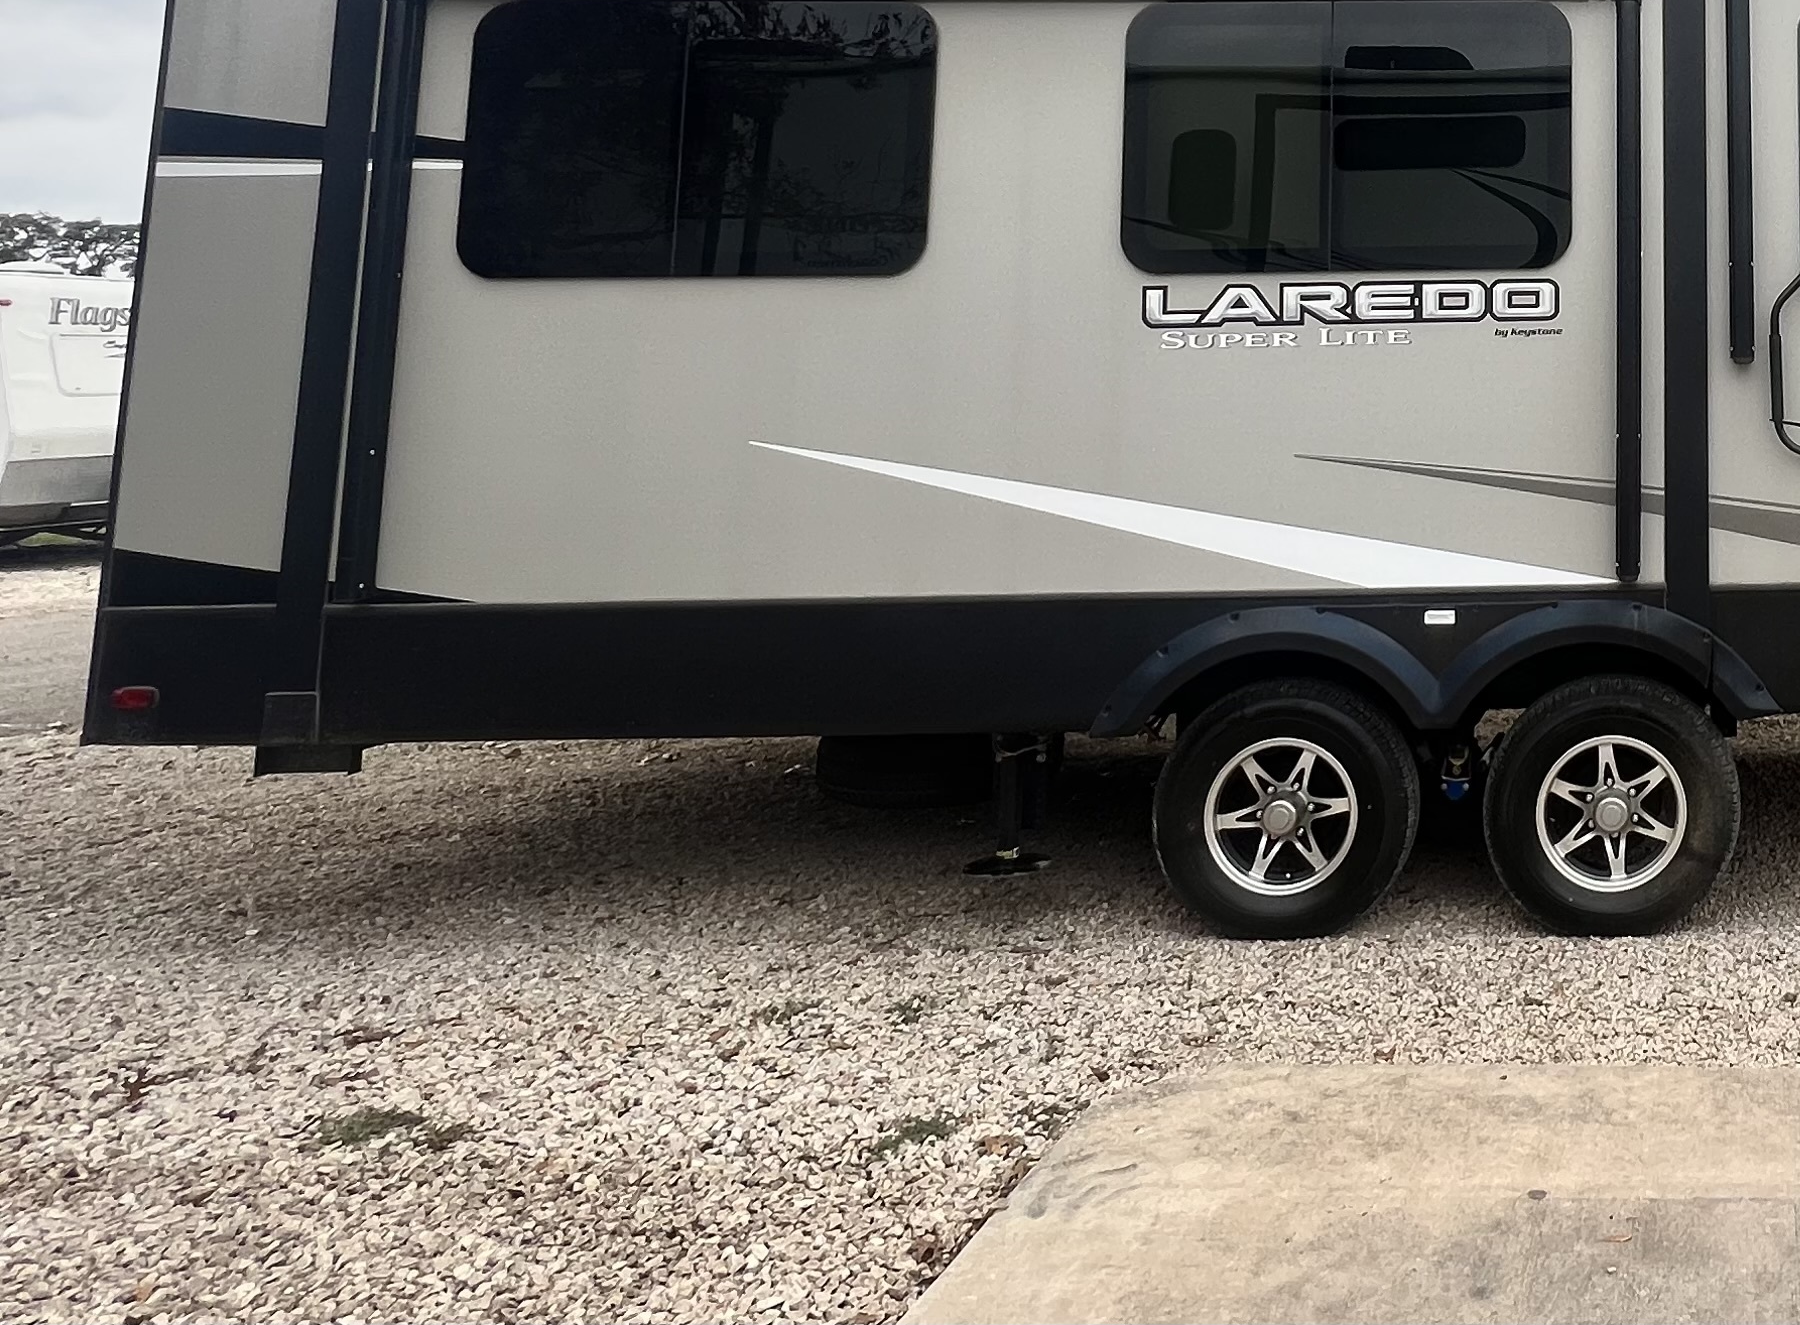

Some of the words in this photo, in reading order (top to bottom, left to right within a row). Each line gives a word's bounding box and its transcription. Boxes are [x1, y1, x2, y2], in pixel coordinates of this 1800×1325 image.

[48, 297, 131, 332] Flags
[1142, 278, 1560, 328] LAREDO
[1495, 328, 1508, 338] by
